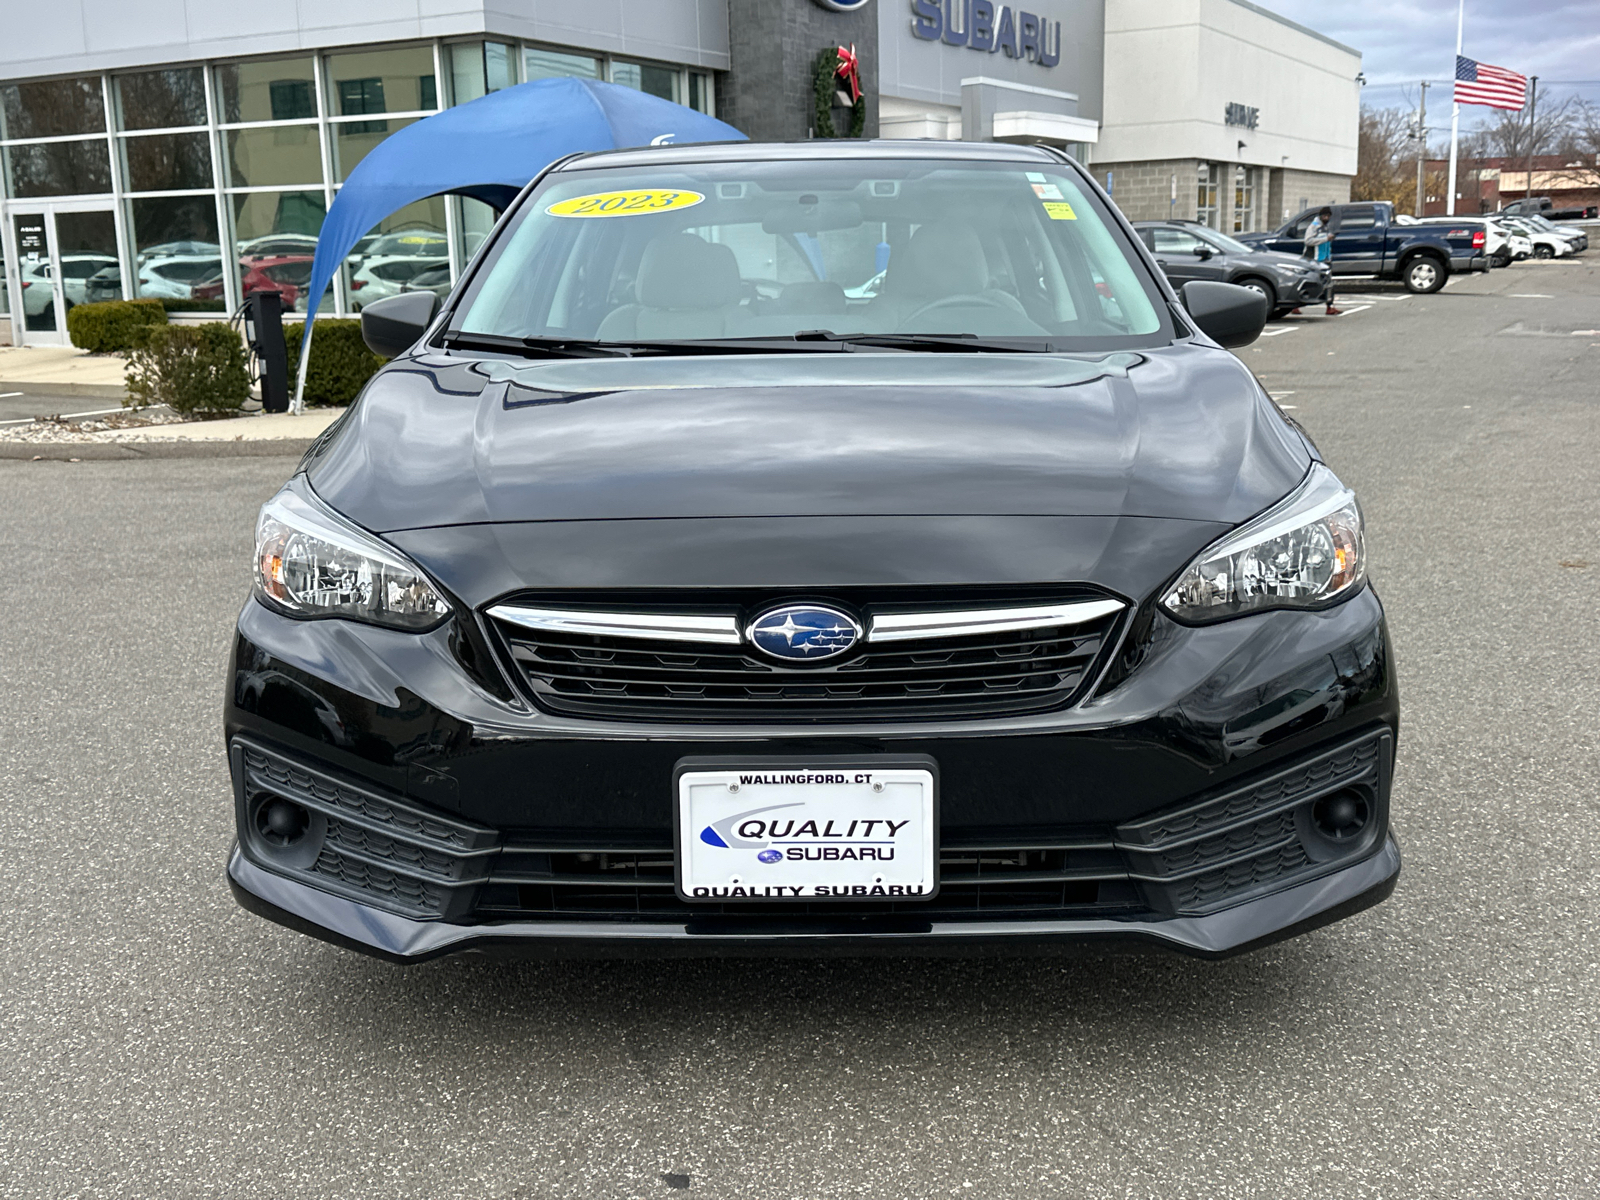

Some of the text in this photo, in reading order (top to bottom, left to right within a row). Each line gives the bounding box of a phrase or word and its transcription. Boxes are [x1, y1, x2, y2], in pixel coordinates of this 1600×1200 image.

[911, 0, 1061, 68] SUBARU
[571, 193, 680, 214] 2023
[854, 774, 873, 784] CT
[738, 820, 910, 838] QUALITY
[786, 847, 895, 861] SUBARU
[693, 885, 923, 897] QUALITY SUBARU
